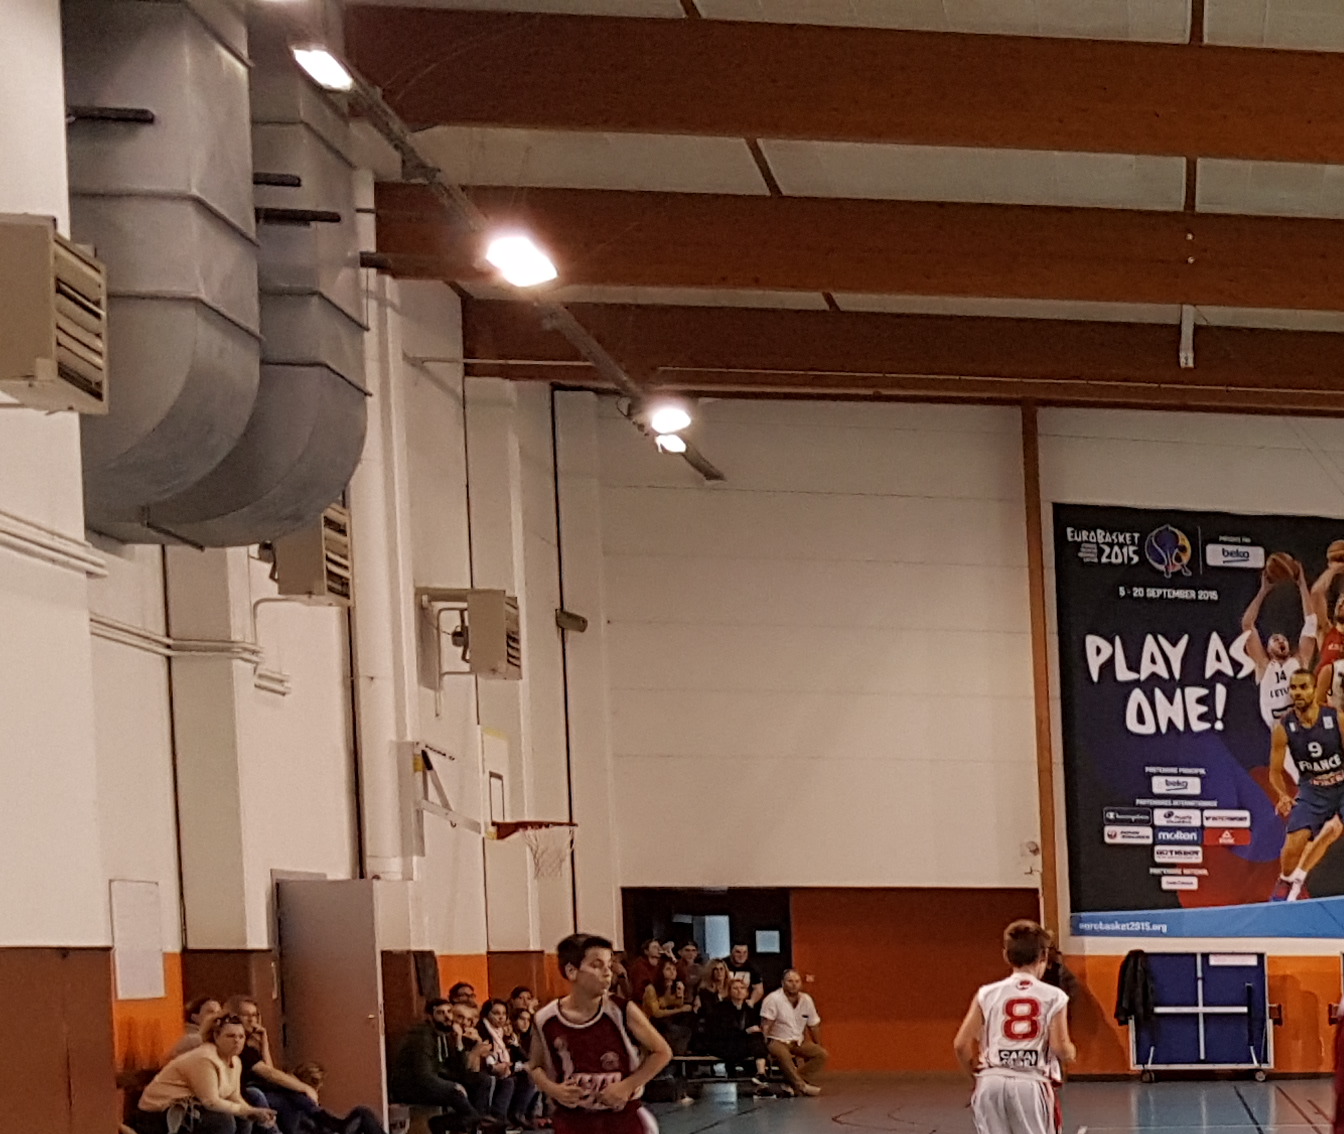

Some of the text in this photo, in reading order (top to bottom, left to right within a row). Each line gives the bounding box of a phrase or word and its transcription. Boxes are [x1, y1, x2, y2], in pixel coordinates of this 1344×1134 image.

[1099, 543, 1140, 565] 2015
[1222, 547, 1250, 560] beko
[1132, 587, 1145, 598] 20
[1146, 588, 1196, 600] SEPTEMBER
[1197, 589, 1219, 601] 2015
[1085, 630, 1257, 683] PLAY AS
[1275, 669, 1288, 684] 14
[1125, 683, 1228, 735] ONE!
[1308, 741, 1323, 758] 9
[1297, 753, 1342, 772] FRANCE
[1158, 830, 1198, 841] molten
[1003, 996, 1041, 1042] 8
